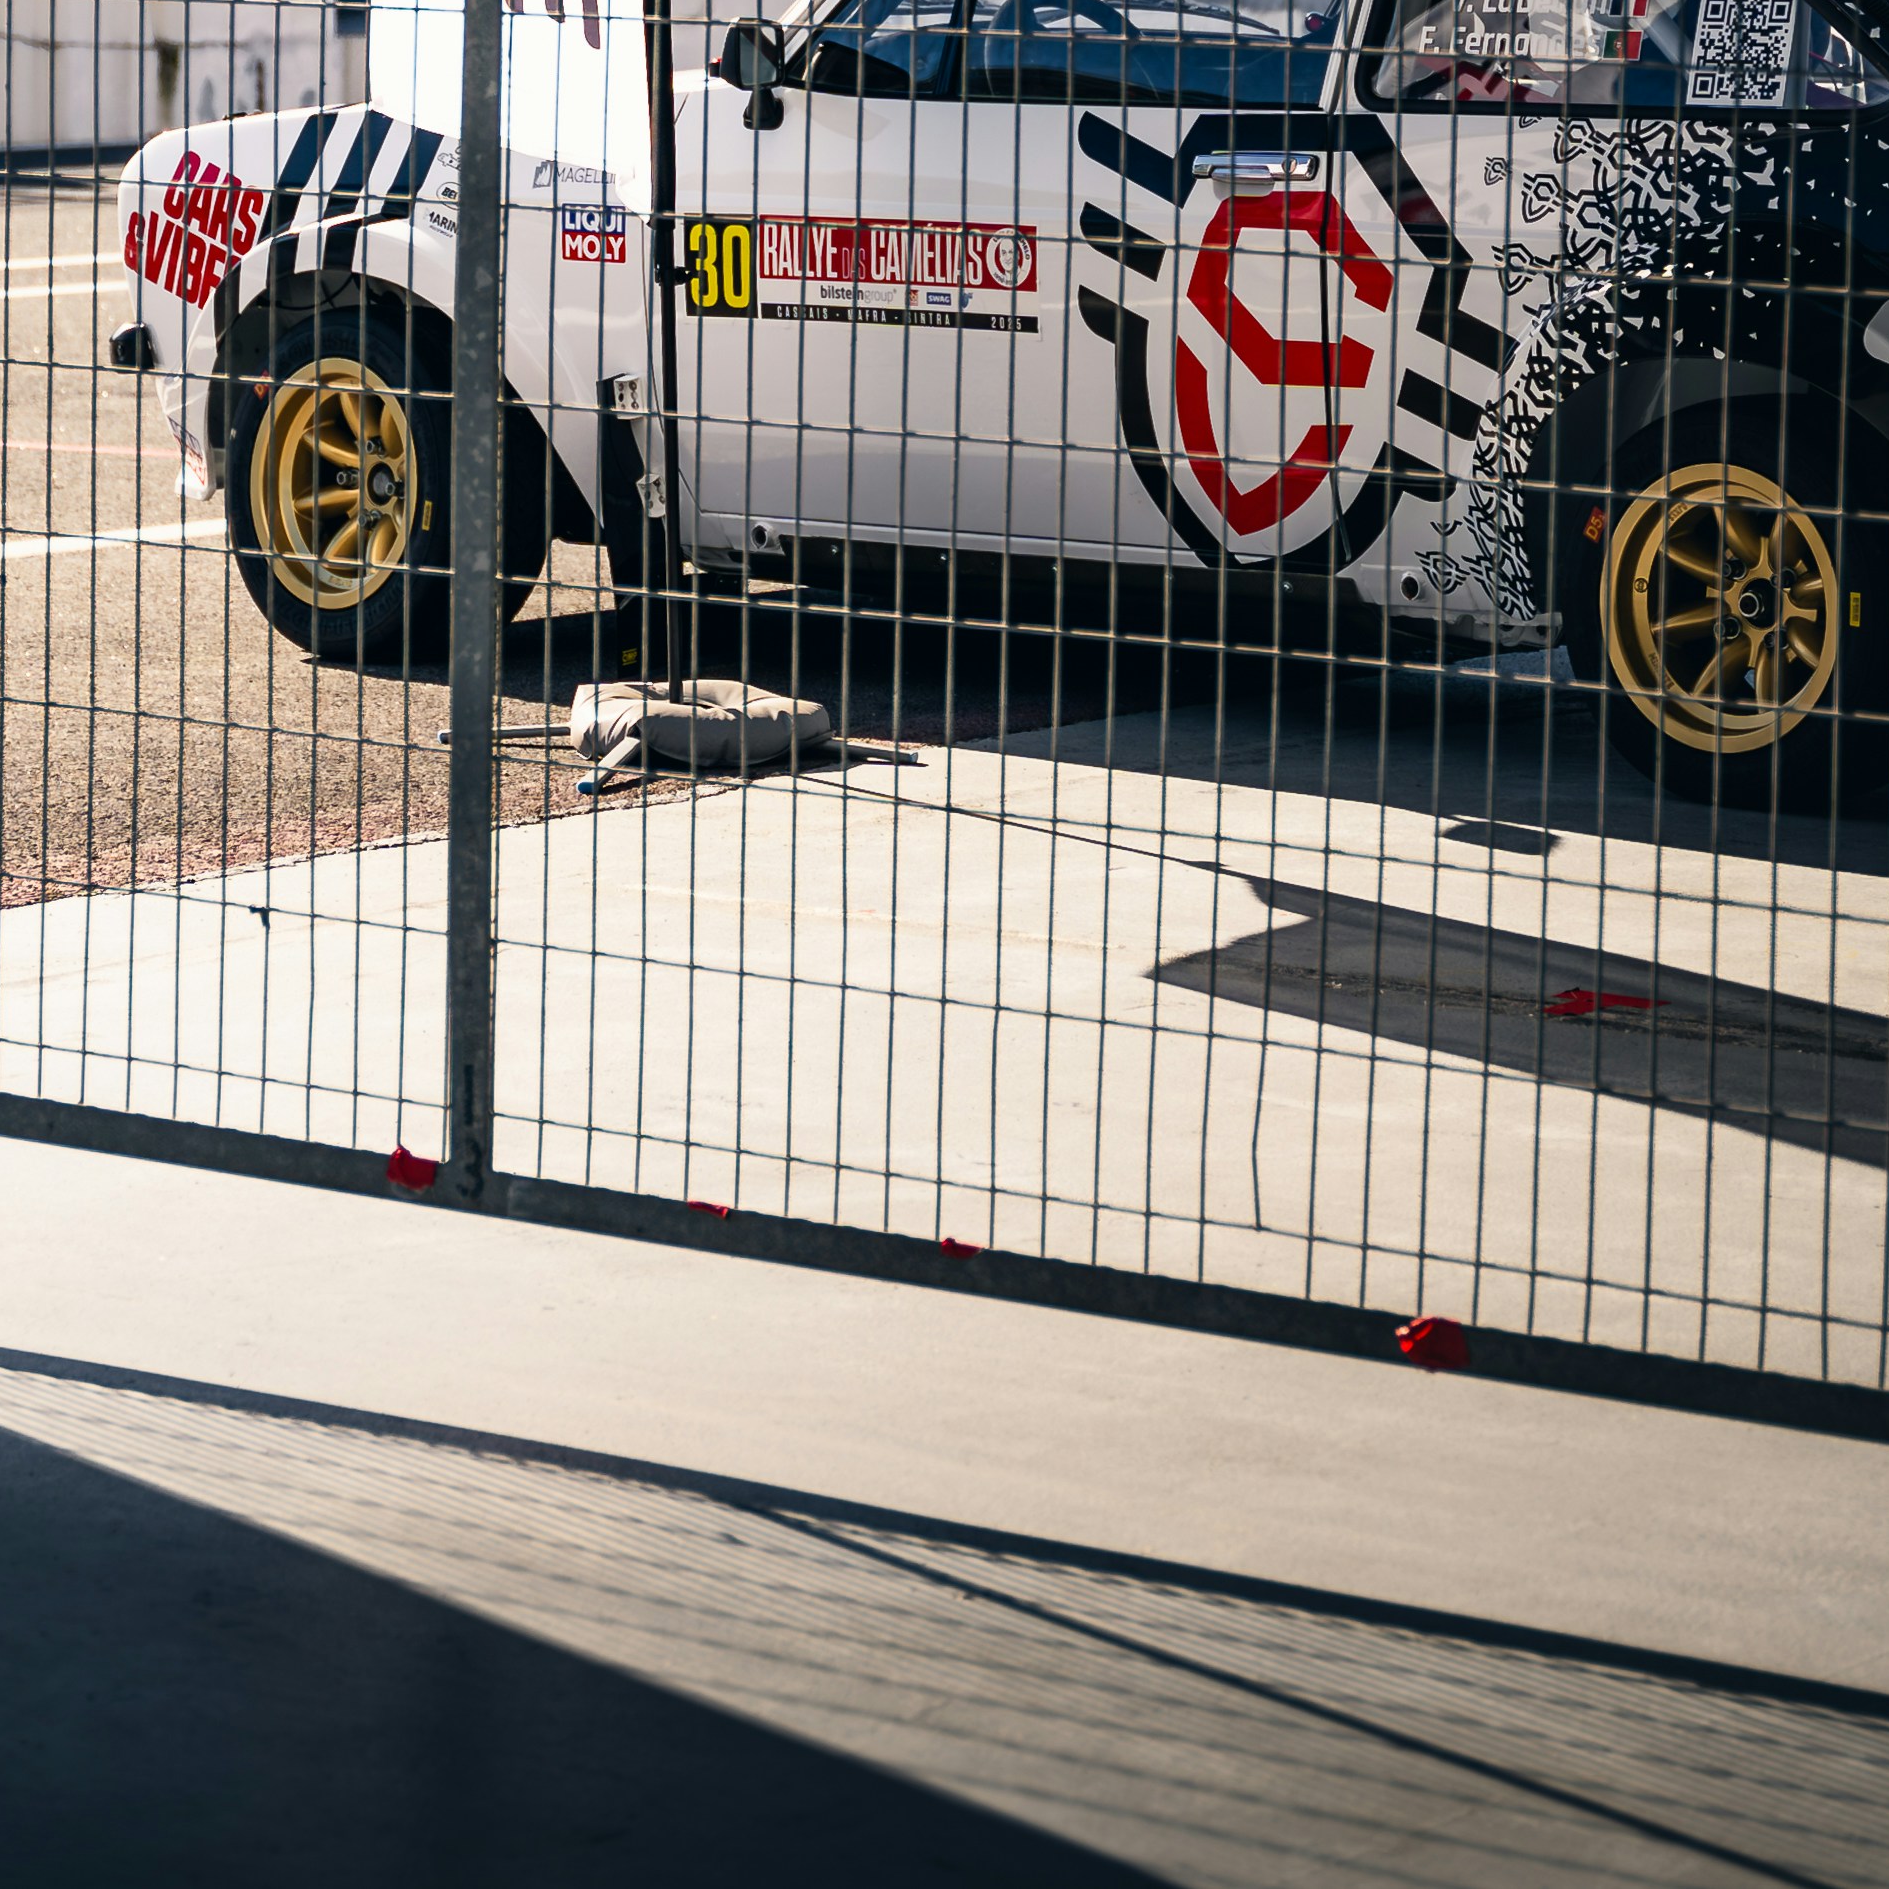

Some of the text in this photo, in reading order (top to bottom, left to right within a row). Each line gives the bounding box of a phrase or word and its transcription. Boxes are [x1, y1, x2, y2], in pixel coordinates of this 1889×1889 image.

[163, 151, 264, 256] CARS
[565, 206, 624, 233] LIQUI
[565, 235, 624, 260] MOLY
[763, 221, 838, 278] RALLYE
[871, 222, 983, 286] CAMÉLIAS
[690, 224, 750, 308] 30
[820, 285, 894, 303] bilstengroup
[927, 295, 951, 303] SWAG
[777, 305, 828, 320] CASAIS
[906, 312, 951, 326] INTRA
[991, 316, 1022, 330] 2025
